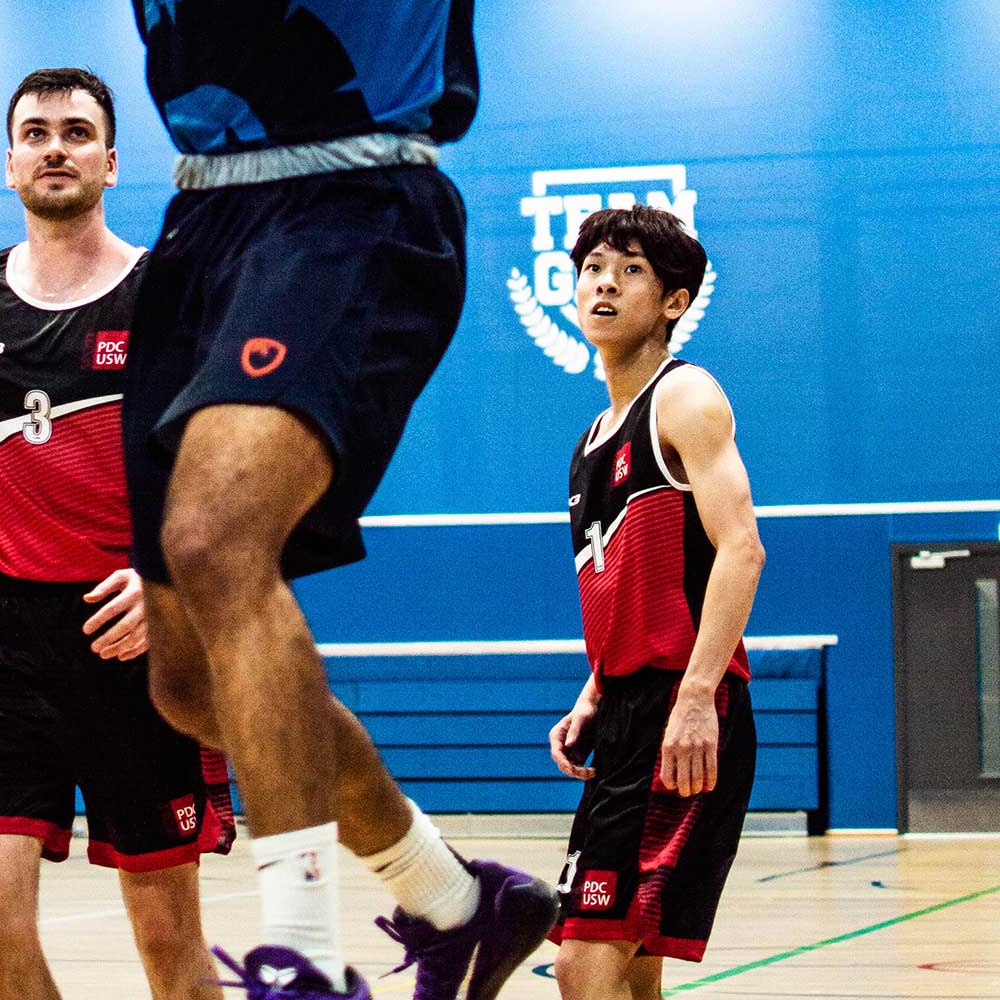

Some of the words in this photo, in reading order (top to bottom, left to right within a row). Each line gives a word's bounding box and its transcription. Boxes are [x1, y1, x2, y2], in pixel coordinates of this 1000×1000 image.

[97, 341, 125, 353] PDC
[96, 353, 127, 365] USW
[22, 389, 52, 445] 3
[585, 520, 604, 574] 1
[180, 816, 196, 831] US
[584, 881, 607, 893] PDC
[583, 894, 611, 906] USW
